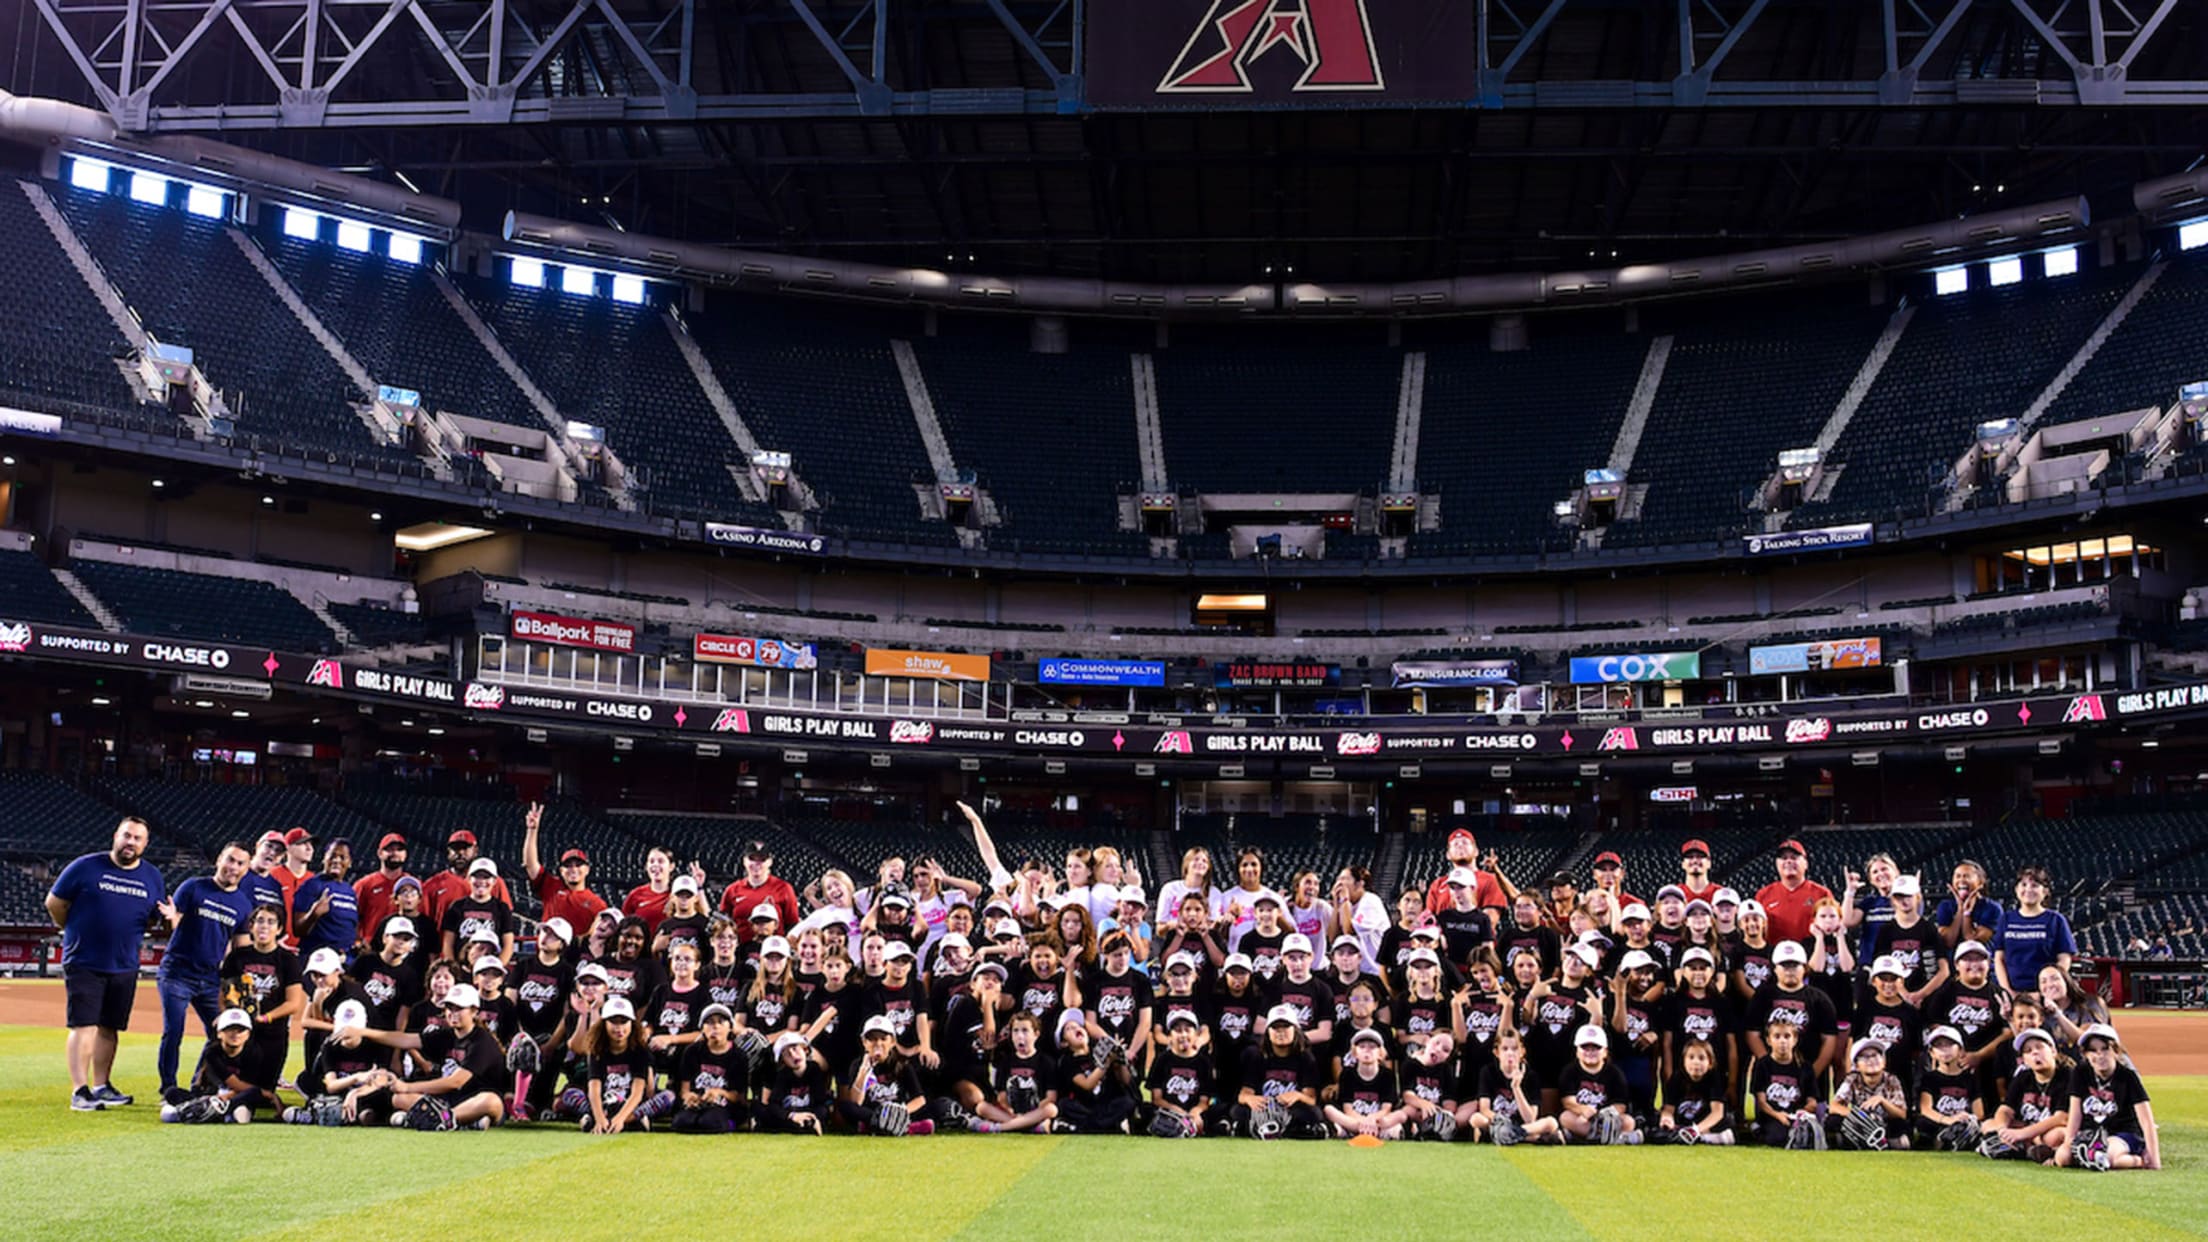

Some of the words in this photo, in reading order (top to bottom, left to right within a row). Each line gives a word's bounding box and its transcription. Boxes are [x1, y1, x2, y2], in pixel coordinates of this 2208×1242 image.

[712, 528, 755, 544] CASINO
[757, 534, 808, 550] ARIZONA
[1764, 539, 1801, 549] TALKING
[1803, 534, 1828, 546] STICK
[532, 620, 590, 640] Ballpark
[40, 635, 111, 653] SUPPORTED
[114, 642, 129, 655] BY
[143, 643, 210, 665] CHASE
[594, 635, 610, 646] FOR
[611, 637, 631, 649] FREE
[700, 641, 736, 653] CIRCLE
[905, 656, 944, 668] shaw
[1061, 662, 1160, 674] COMMONWEALTH
[1229, 665, 1250, 678] ZAC
[1253, 665, 1293, 678] BROWN
[1297, 665, 1326, 678] BAND
[1598, 655, 1670, 681] COX
[355, 670, 391, 691] GIRLS
[393, 676, 424, 697] PLAY
[425, 680, 455, 700] BALL
[511, 695, 563, 710] SUPPORTED
[565, 701, 577, 711] BY
[587, 701, 637, 718] CHASE
[2117, 692, 2154, 714] GIRLS
[2156, 687, 2189, 708] PLAY
[764, 716, 803, 733] GIRLS
[806, 719, 840, 736] PLAY
[842, 721, 876, 738] BALL
[1836, 721, 1892, 733] SUPPORTED
[1894, 720, 1908, 730] BY
[1919, 712, 1972, 729] CHASE
[939, 729, 991, 741] SUPPORTED
[993, 732, 1005, 741] BY
[1015, 731, 1068, 745] CHASE
[1207, 736, 1247, 750] GIRLS
[1251, 736, 1286, 751] PLAY
[1289, 736, 1323, 751] BALL
[1387, 738, 1441, 748] SUPPORTED
[1443, 738, 1455, 748] BY
[1466, 735, 1519, 748] CHASE
[1652, 729, 1694, 745] GIRLS
[1698, 727, 1735, 744] PLAY
[1737, 725, 1772, 741] BALL
[99, 881, 148, 899] VOLUNTEER
[198, 907, 236, 927] VOLUNTEER
[2004, 930, 2047, 939] VOLUNTEER
[1099, 995, 1135, 1014] Girls
[1949, 1003, 1993, 1023] Girls
